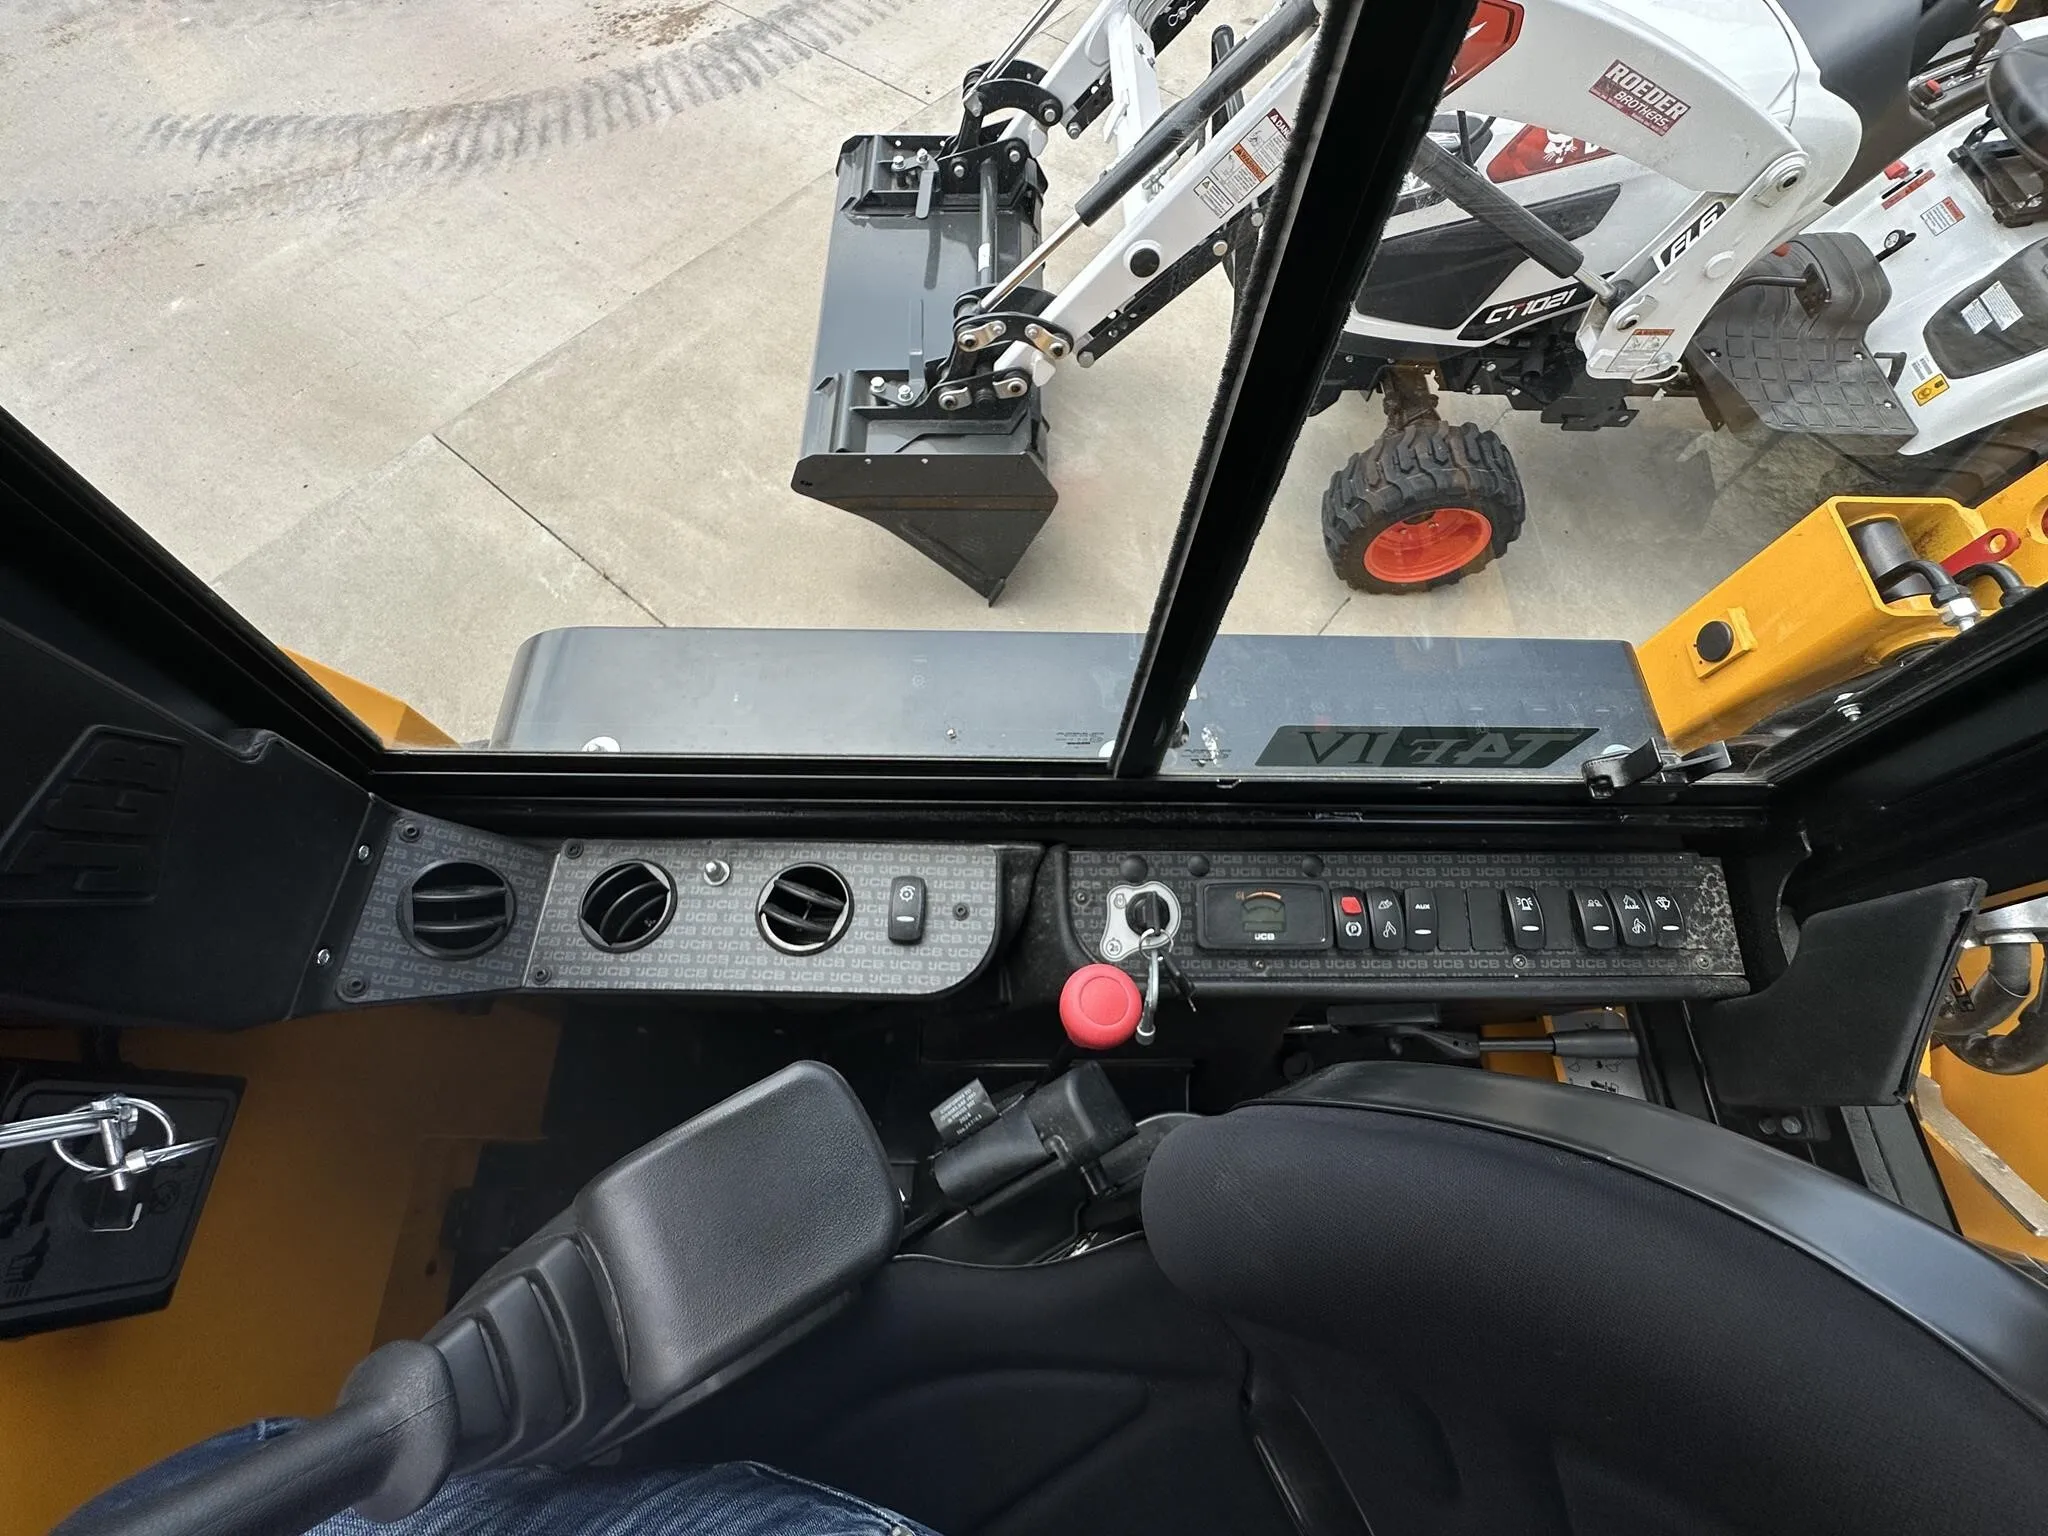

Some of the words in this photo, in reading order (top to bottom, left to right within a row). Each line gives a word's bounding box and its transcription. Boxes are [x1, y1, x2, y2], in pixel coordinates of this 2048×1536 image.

[1604, 62, 1689, 118] ROEDER
[1613, 92, 1669, 129] BROTHERS
[1485, 288, 1577, 325] CT1021
[1254, 933, 1275, 941] JCB
